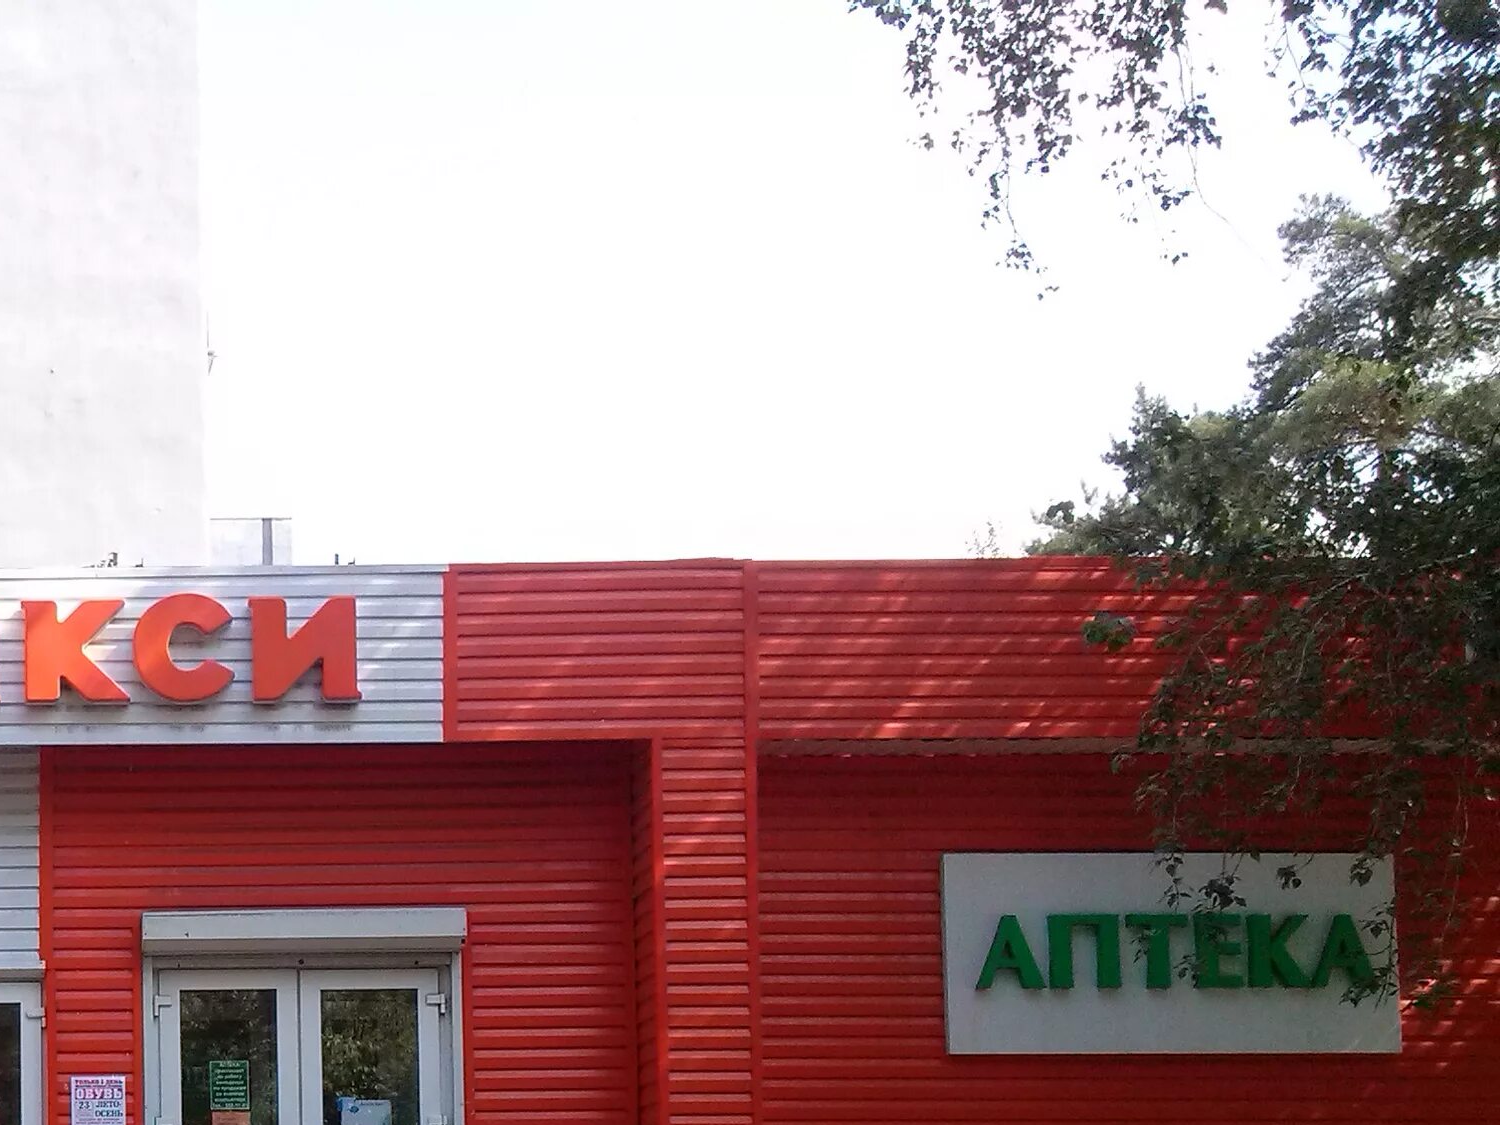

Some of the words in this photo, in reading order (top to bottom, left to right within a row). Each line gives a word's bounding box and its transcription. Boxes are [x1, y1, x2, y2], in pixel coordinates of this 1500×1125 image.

[975, 914, 1379, 990] АПТЕКА
[75, 1088, 123, 1099] ОБУВЬ
[78, 1101, 91, 1109] 23
